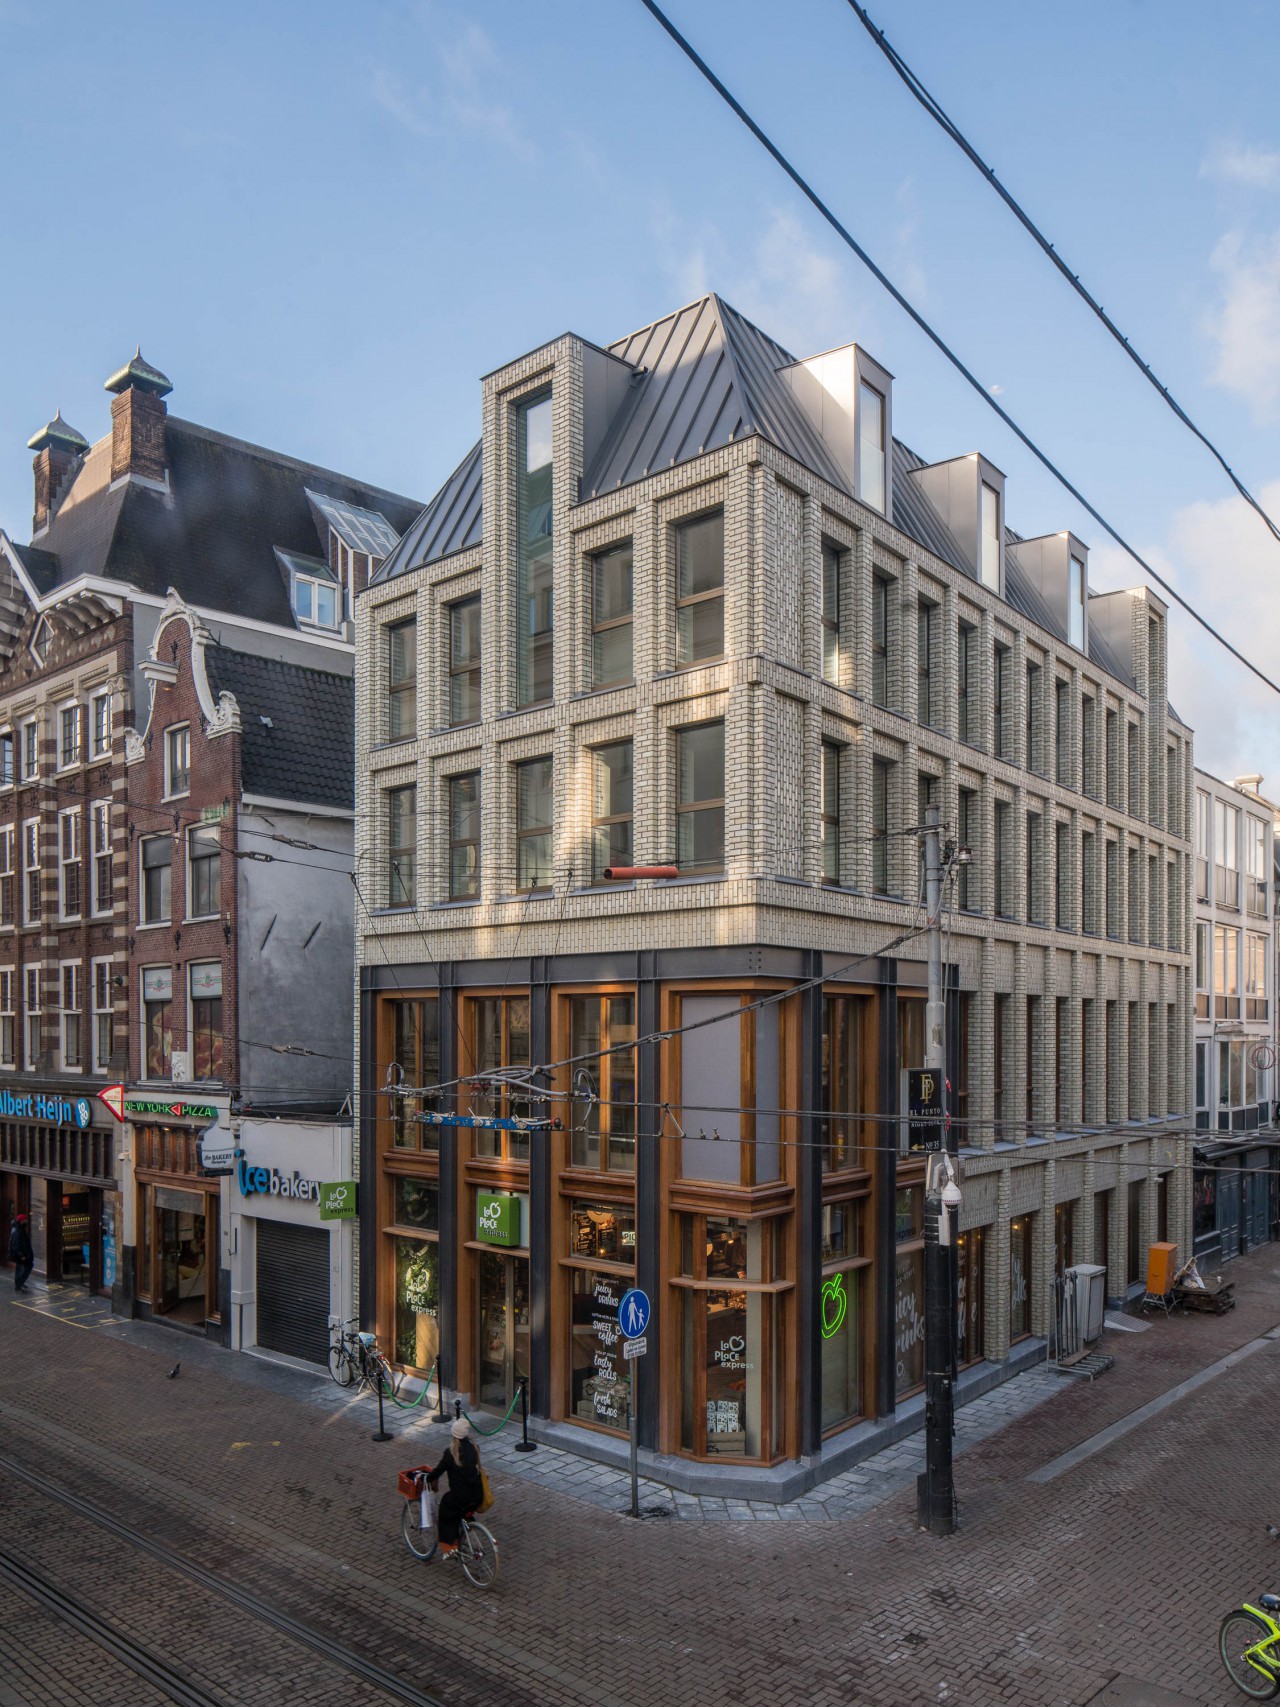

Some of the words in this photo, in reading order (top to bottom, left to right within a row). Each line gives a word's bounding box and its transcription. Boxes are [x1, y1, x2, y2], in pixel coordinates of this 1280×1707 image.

[36, 1094, 72, 1126] Heijn
[125, 1102, 145, 1112] NEW
[147, 1103, 172, 1115] YORK
[182, 1106, 212, 1117] PIZZA
[921, 1107, 941, 1116] PUNTO
[330, 1207, 354, 1215] express
[484, 1229, 508, 1238] express
[593, 1283, 612, 1299] juicy
[411, 1304, 437, 1316] express
[592, 1320, 612, 1332] SWEET
[895, 1312, 925, 1353] rinks
[598, 1331, 619, 1346] coffee
[593, 1354, 613, 1371] tasty
[721, 1360, 755, 1370] express
[599, 1368, 617, 1381] ROLLS
[597, 1404, 618, 1418] SALADS
